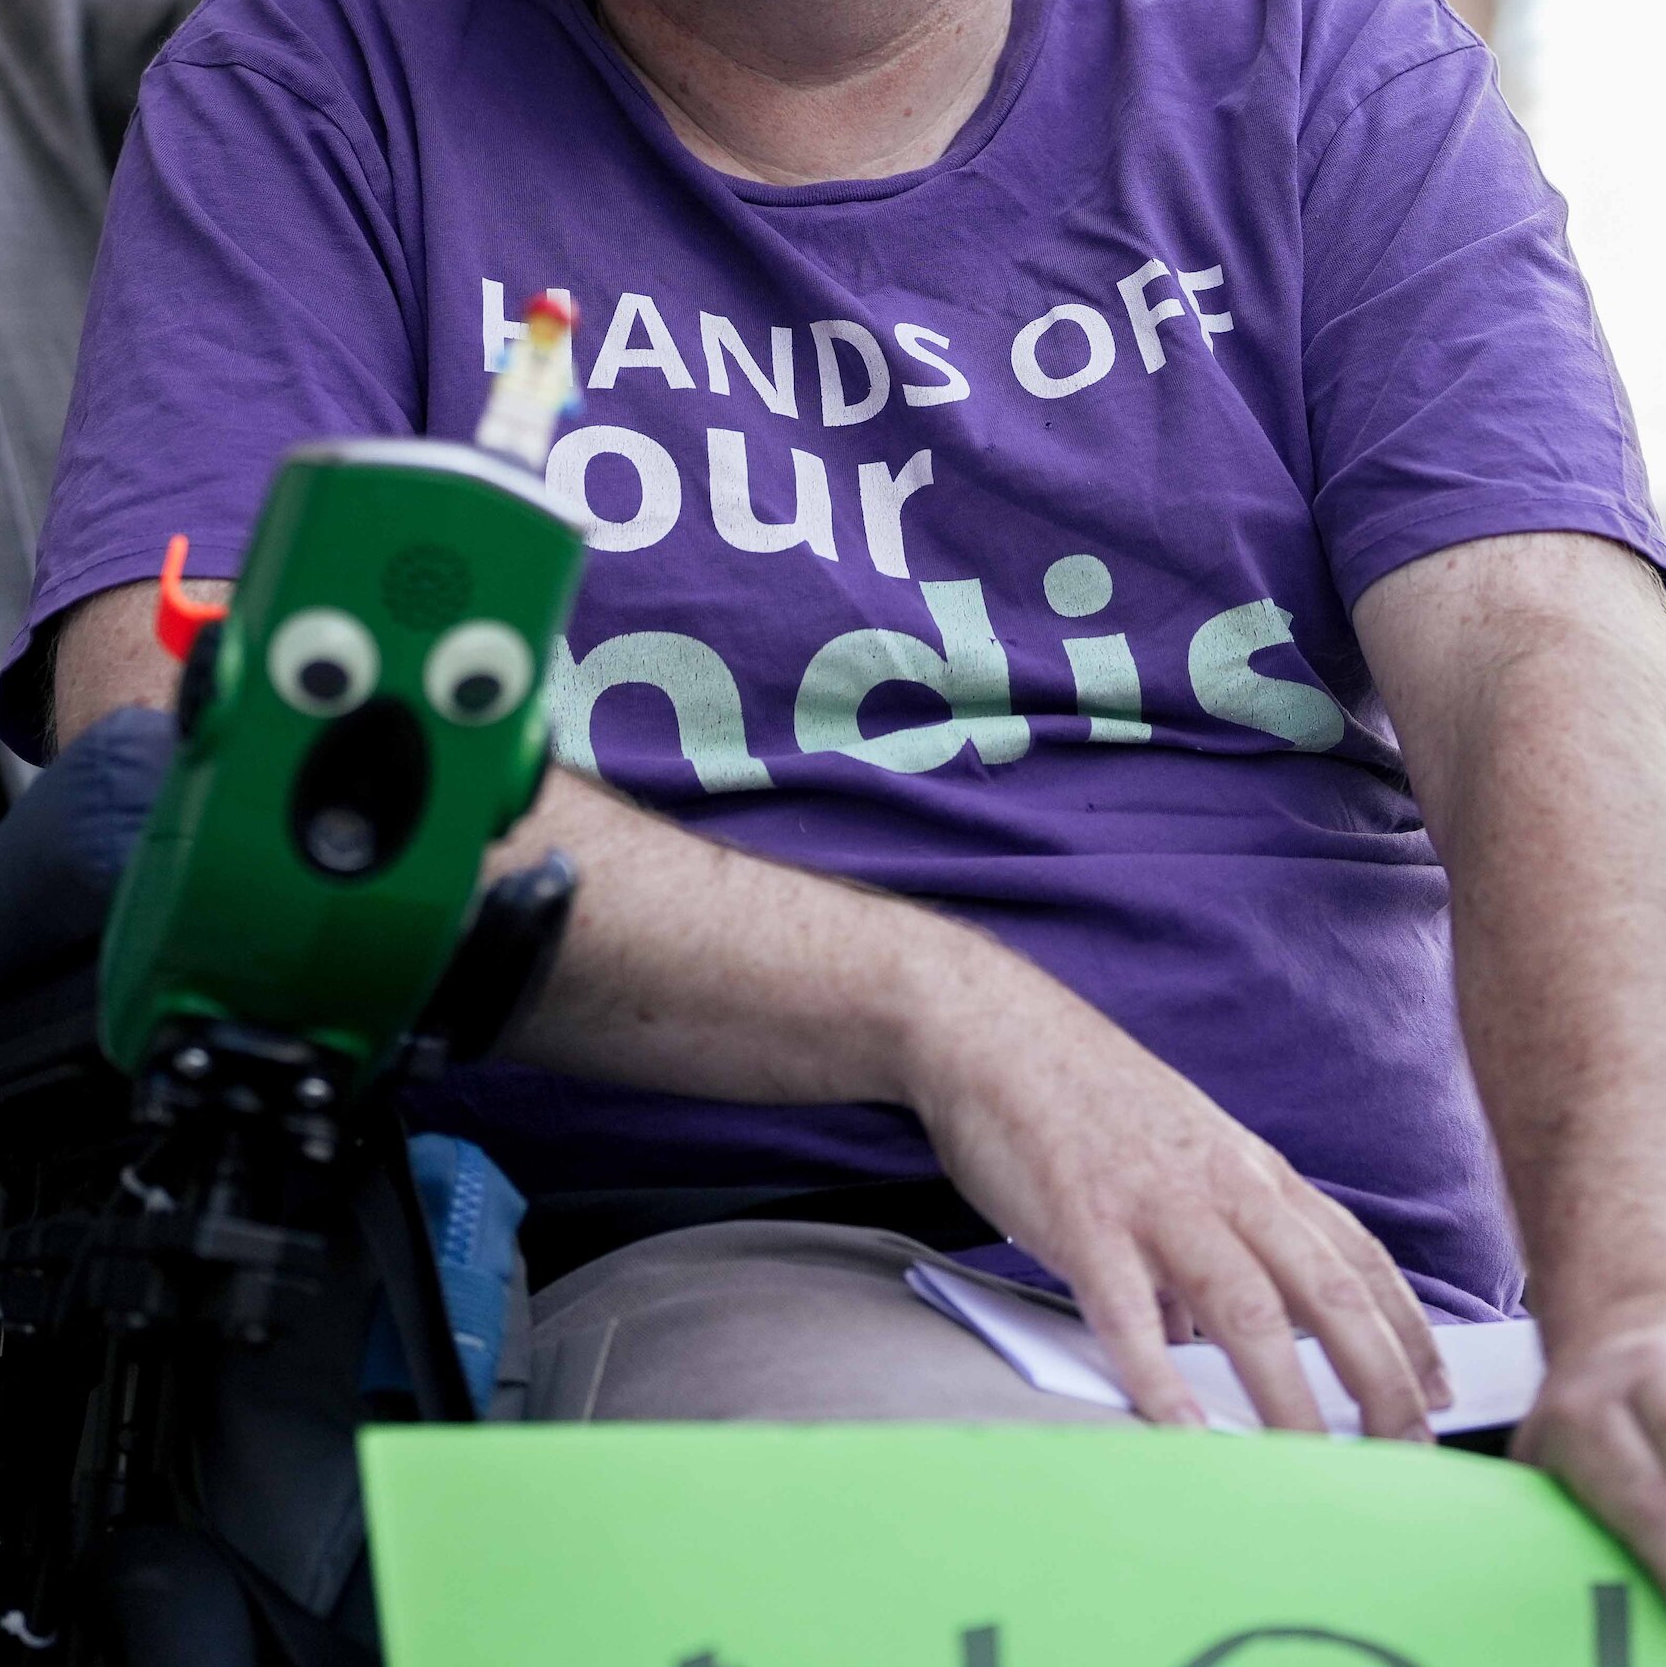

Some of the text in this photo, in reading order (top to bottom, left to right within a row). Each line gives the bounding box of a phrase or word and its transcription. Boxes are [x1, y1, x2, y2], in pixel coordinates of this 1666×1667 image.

[481, 258, 1236, 428] HANDS OFF
[545, 424, 935, 580] our
[541, 553, 1344, 794] ndis
